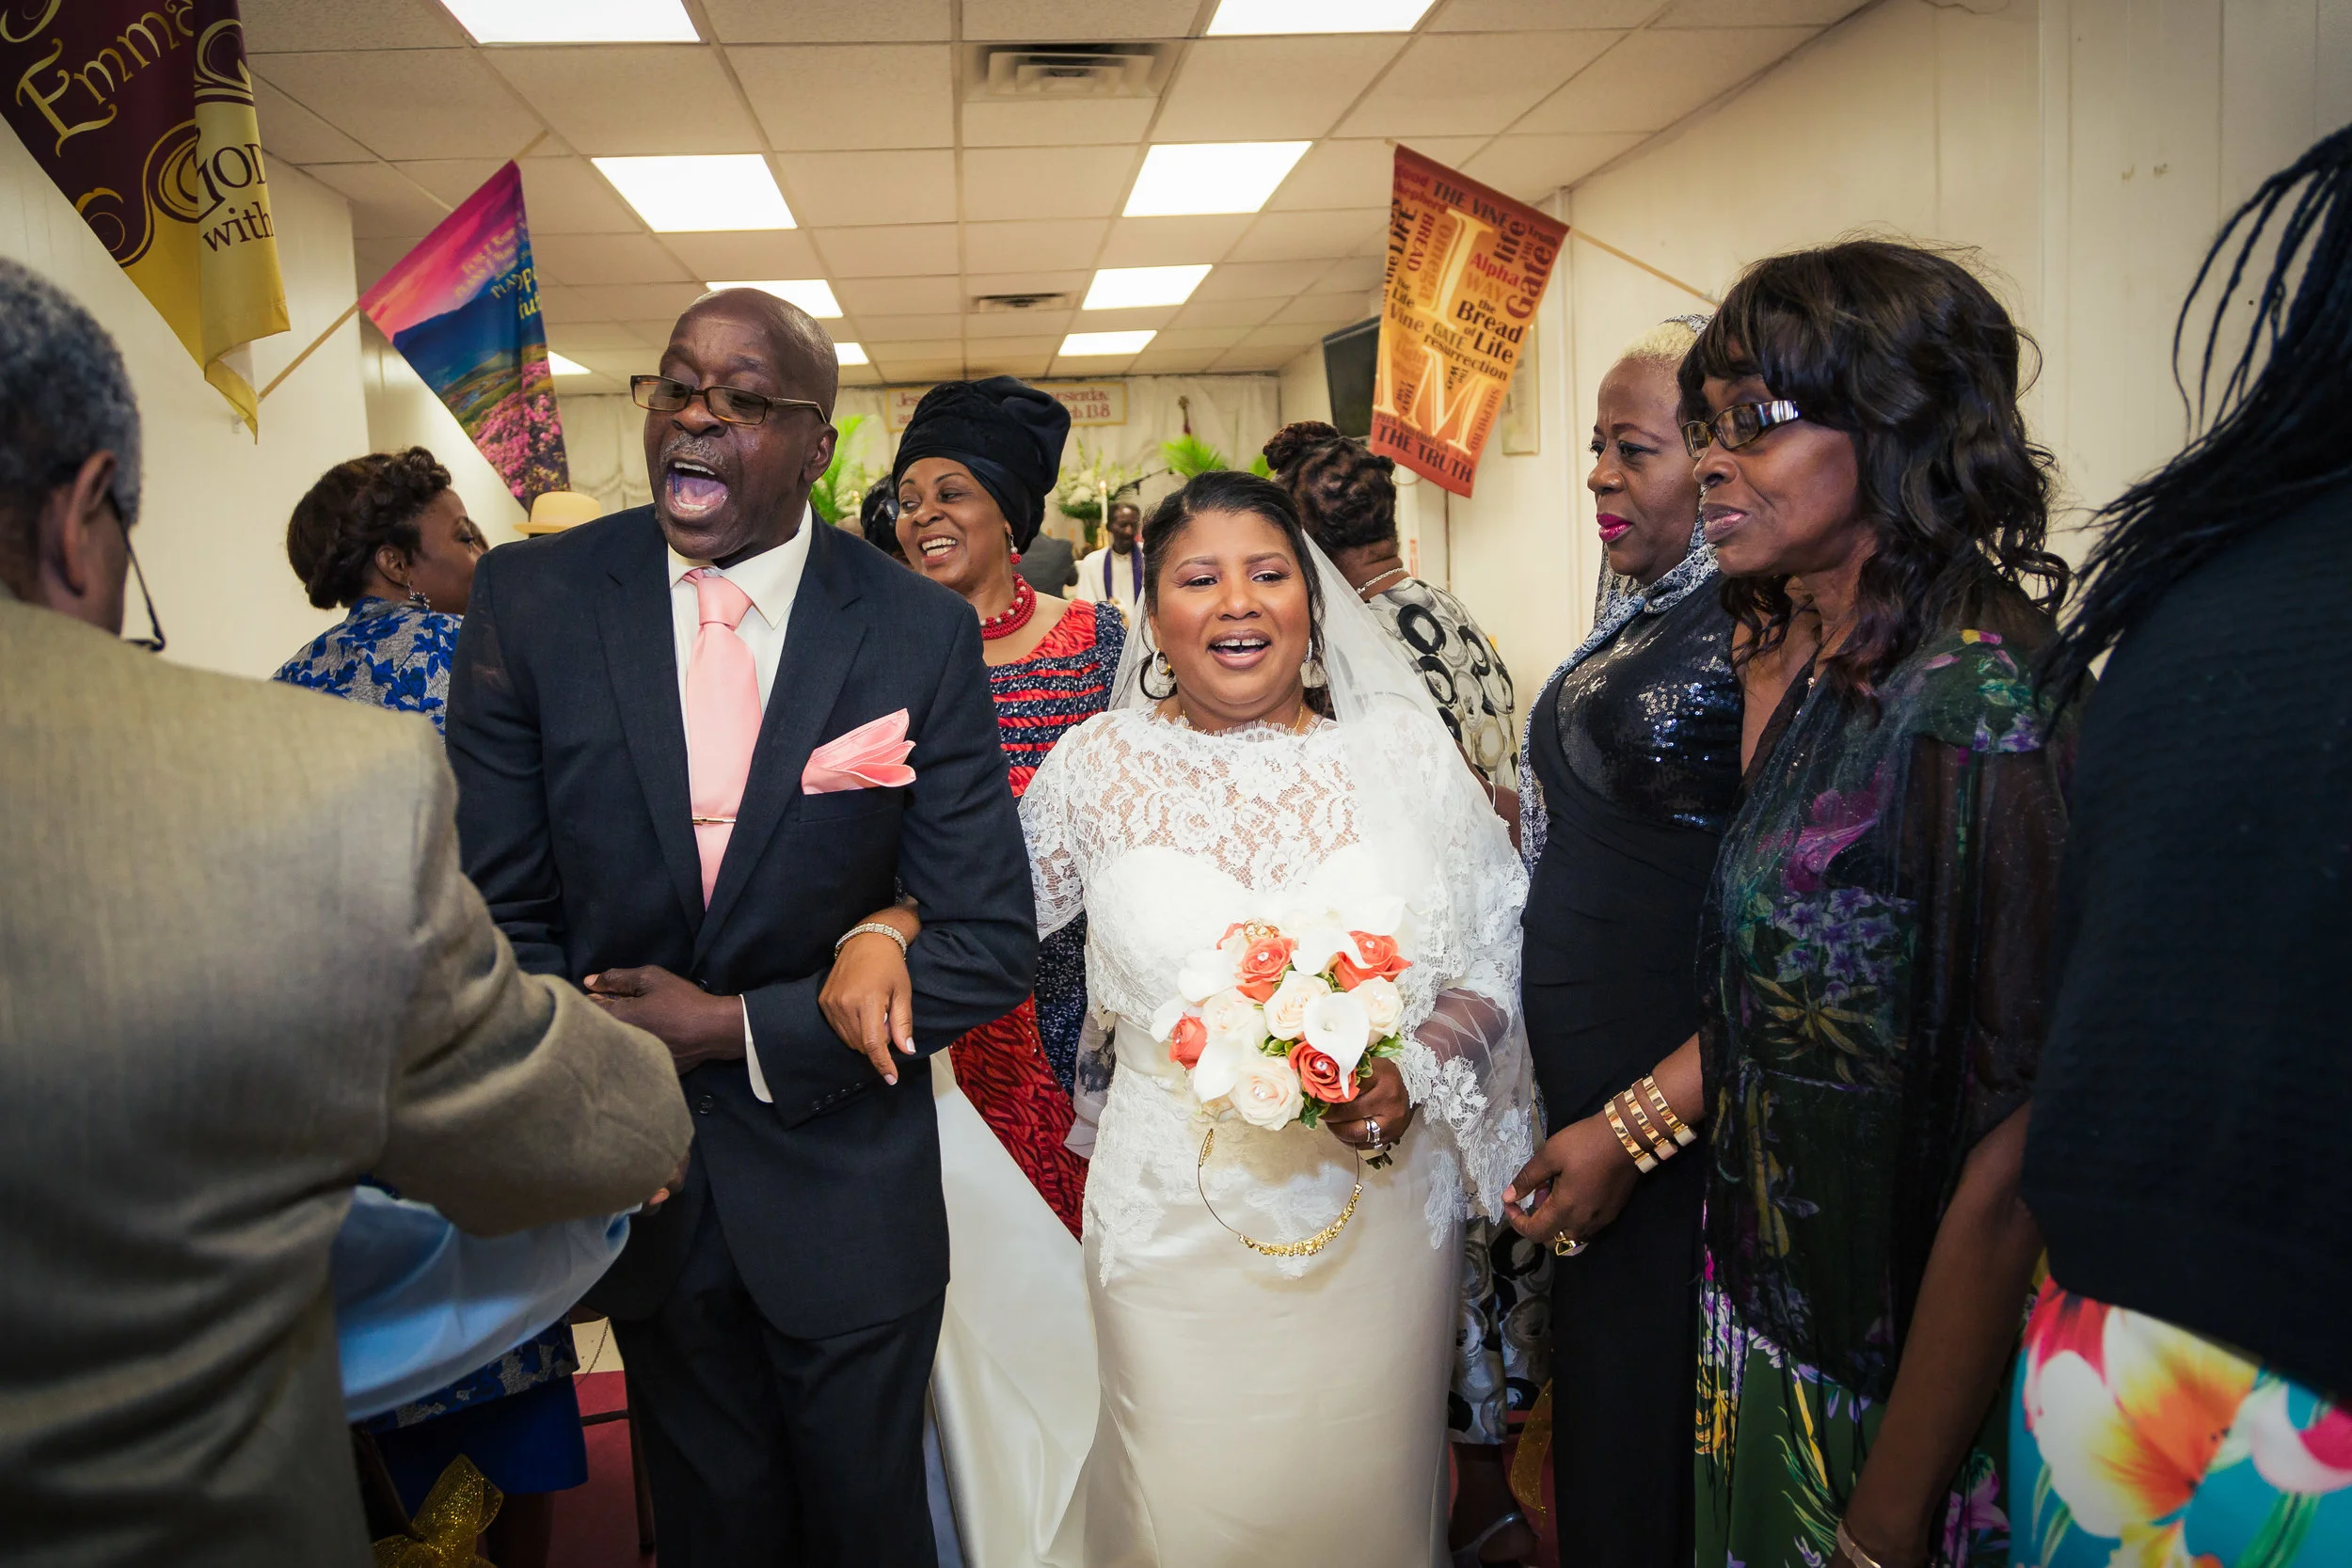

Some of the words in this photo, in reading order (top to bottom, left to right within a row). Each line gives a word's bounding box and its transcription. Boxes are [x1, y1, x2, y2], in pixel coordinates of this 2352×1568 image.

[202, 201, 274, 252] with
[1434, 179, 1467, 208] THE
[1471, 197, 1511, 230] VINE
[1406, 212, 1436, 272] BREAD
[1492, 219, 1526, 264] life
[1465, 271, 1507, 303] WAY
[1470, 251, 1520, 287] Alpha
[1505, 245, 1552, 320] Gate
[1391, 286, 1416, 309] Life
[1391, 302, 1425, 333] Vine
[1477, 298, 1498, 315] the
[1433, 321, 1469, 352] GATE
[1455, 299, 1524, 344] Bread
[1422, 332, 1508, 382] resurrection
[1473, 330, 1515, 365] Life
[1470, 387, 1501, 451] SHEPHERD
[1377, 423, 1412, 452] THE
[1417, 442, 1473, 483] TRUTH
